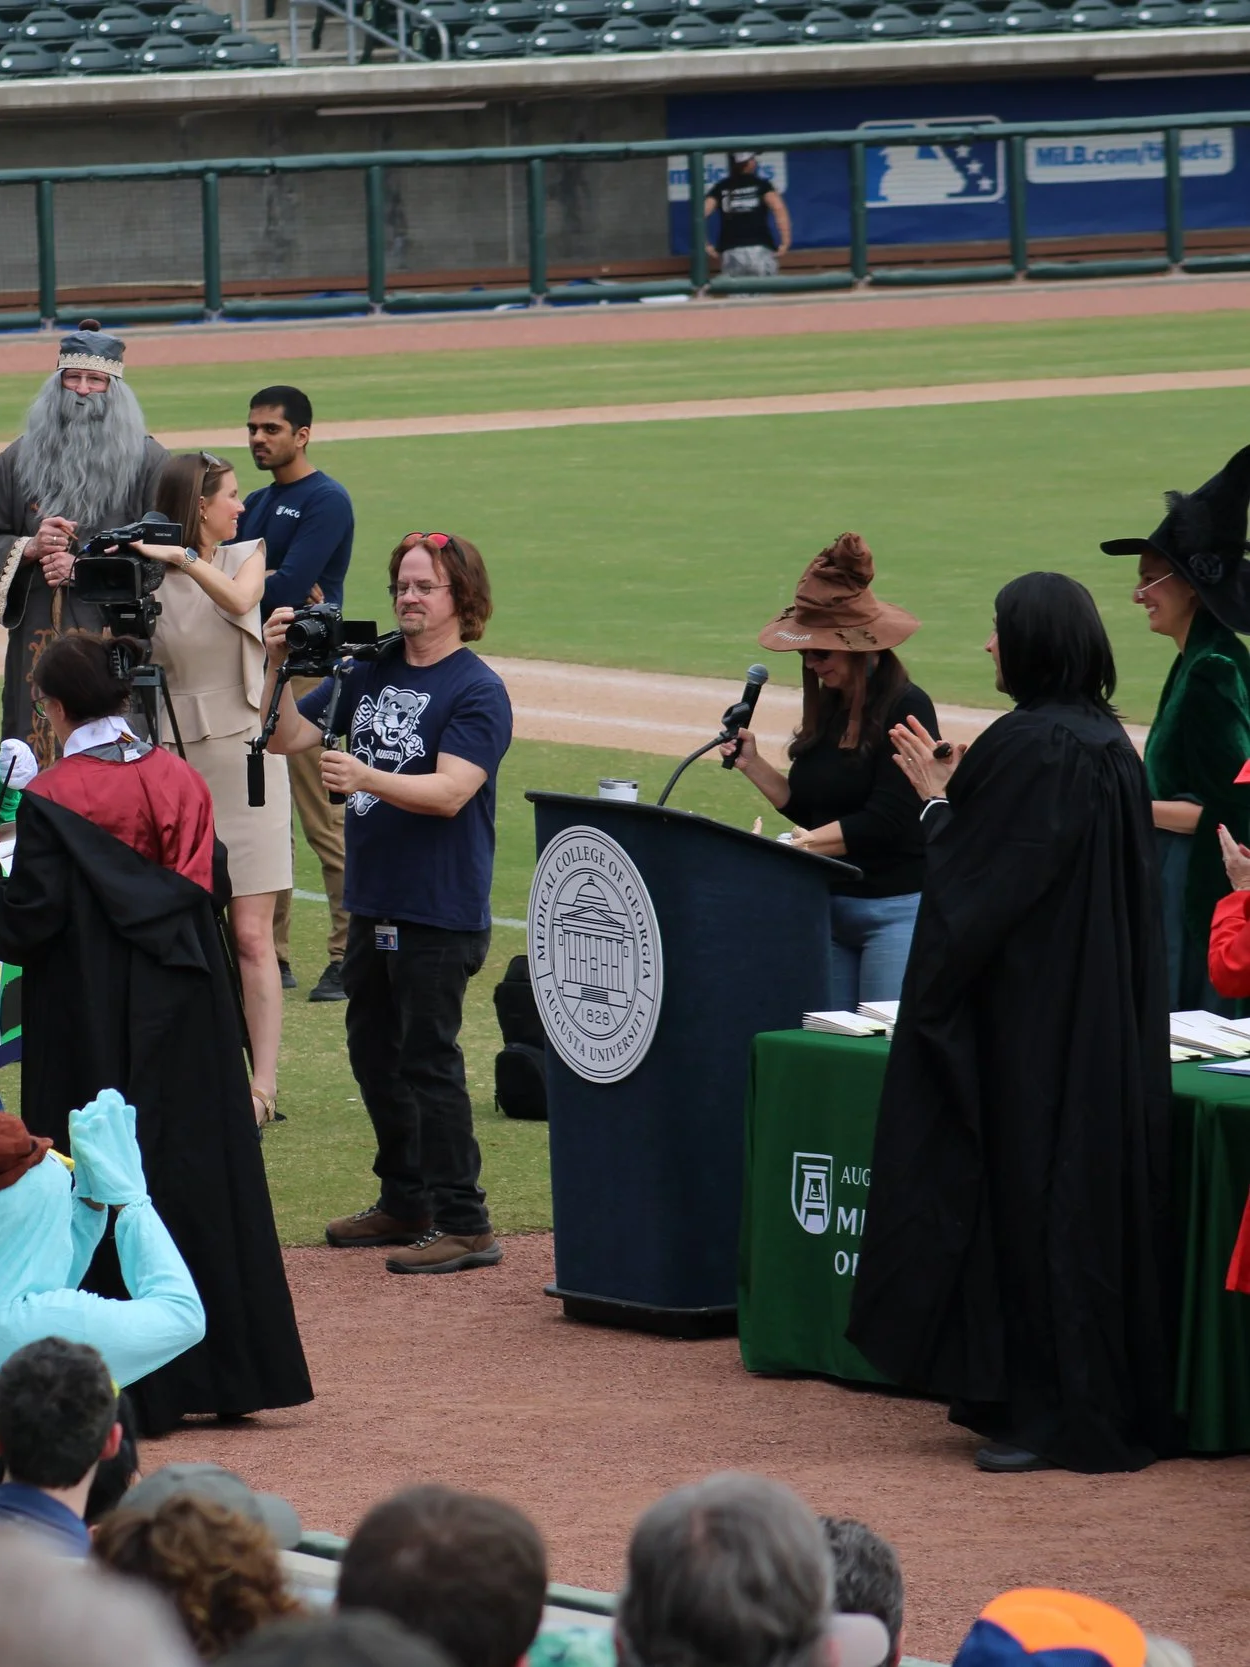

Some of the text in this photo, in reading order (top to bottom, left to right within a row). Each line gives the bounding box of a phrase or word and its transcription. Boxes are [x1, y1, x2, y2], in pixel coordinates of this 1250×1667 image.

[283, 508, 300, 518] MCG
[375, 749, 402, 762] AUGUSTA
[536, 845, 652, 981] MEDICAL COLLEGE OF GEORGIA
[544, 988, 647, 1063] AUGUSTA UNIVERSITY
[580, 1007, 611, 1027] 1828
